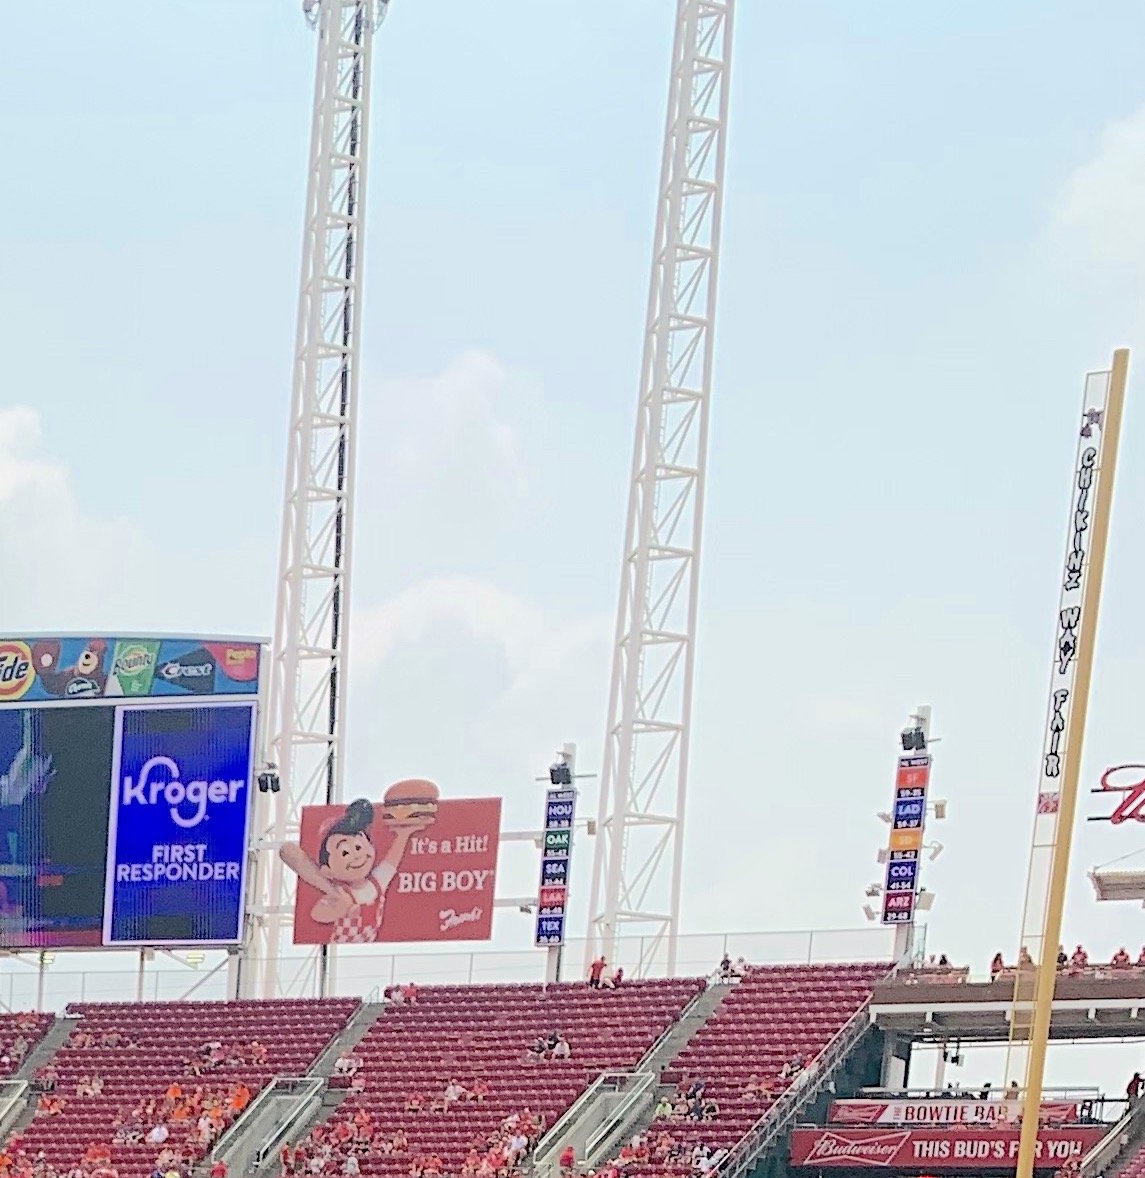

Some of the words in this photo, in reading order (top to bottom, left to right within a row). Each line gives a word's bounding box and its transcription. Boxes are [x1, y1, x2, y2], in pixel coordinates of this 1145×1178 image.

[1063, 447, 1096, 590] CHIKINZ
[1059, 606, 1082, 674] WAY
[1045, 688, 1069, 777] FAIR
[123, 756, 244, 828] Kroger
[548, 804, 572, 816] HOU
[898, 804, 921, 815] LAD
[411, 837, 438, 854] It's
[441, 841, 453, 853] a
[456, 834, 488, 852] Hit!
[546, 834, 569, 845] OAK
[151, 844, 208, 863] FIRST
[116, 861, 241, 883] RESPONDER
[545, 863, 565, 874] SEA
[891, 866, 913, 876] COL
[397, 871, 436, 893] BIG
[440, 869, 490, 892] BOY
[542, 920, 560, 931] TEX
[905, 1106, 969, 1121] BOWTIE
[814, 1139, 898, 1157] Budweiser
[913, 1140, 952, 1159] THIS
[954, 1140, 1005, 1159] BUD'S
[1009, 1141, 1042, 1159] FR
[1047, 1141, 1083, 1159] YOU
